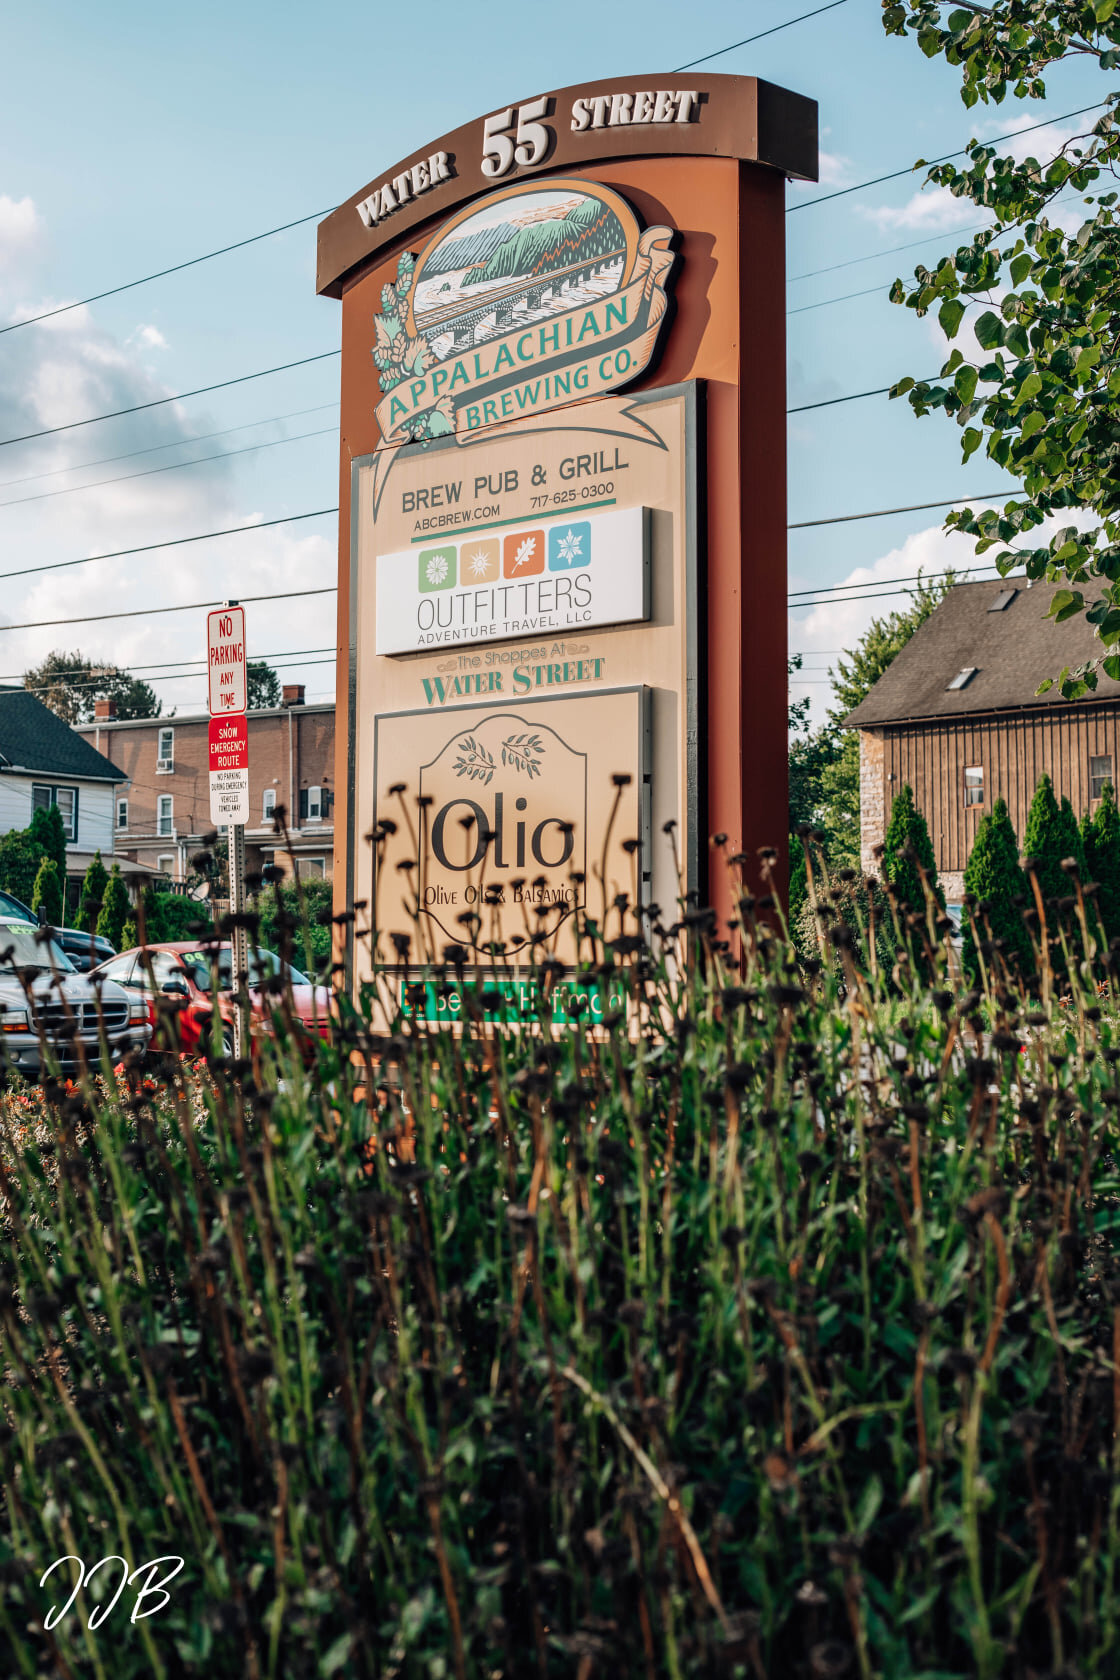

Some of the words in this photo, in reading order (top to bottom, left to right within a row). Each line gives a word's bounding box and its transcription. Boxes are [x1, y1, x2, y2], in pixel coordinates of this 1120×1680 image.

[355, 151, 452, 228] WATER
[480, 97, 549, 178] 55
[570, 90, 699, 132] STREET
[387, 296, 629, 426] APPALACHIAN
[466, 363, 590, 429] BREWING
[599, 347, 638, 381] CO.
[401, 480, 462, 513] BREW
[474, 469, 519, 499] PUB
[531, 464, 547, 487] &
[559, 447, 629, 480] GRILL
[413, 504, 500, 532] ABCBREW.COM
[530, 481, 615, 509] 717-625-0300
[417, 573, 592, 631] OUTFITTERS
[219, 617, 233, 638] NO
[417, 623, 497, 645] ADVENTURE
[503, 616, 559, 633] TRAVEL,
[566, 610, 592, 624] LLC
[210, 643, 242, 666] PARKING
[457, 653, 481, 668] The
[484, 646, 547, 670] Shoppes
[550, 641, 566, 656] At
[220, 671, 234, 686] ANY
[420, 671, 503, 705] WATER
[512, 657, 606, 696] STREET
[220, 692, 236, 707] TIME
[210, 740, 246, 754] EMERGENCY
[218, 727, 238, 739] SNOW
[217, 755, 240, 767] ROUTE
[216, 773, 223, 781] NO
[223, 771, 241, 780] PARKING
[221, 795, 239, 803] VEHICLES
[431, 792, 574, 871] Olio
